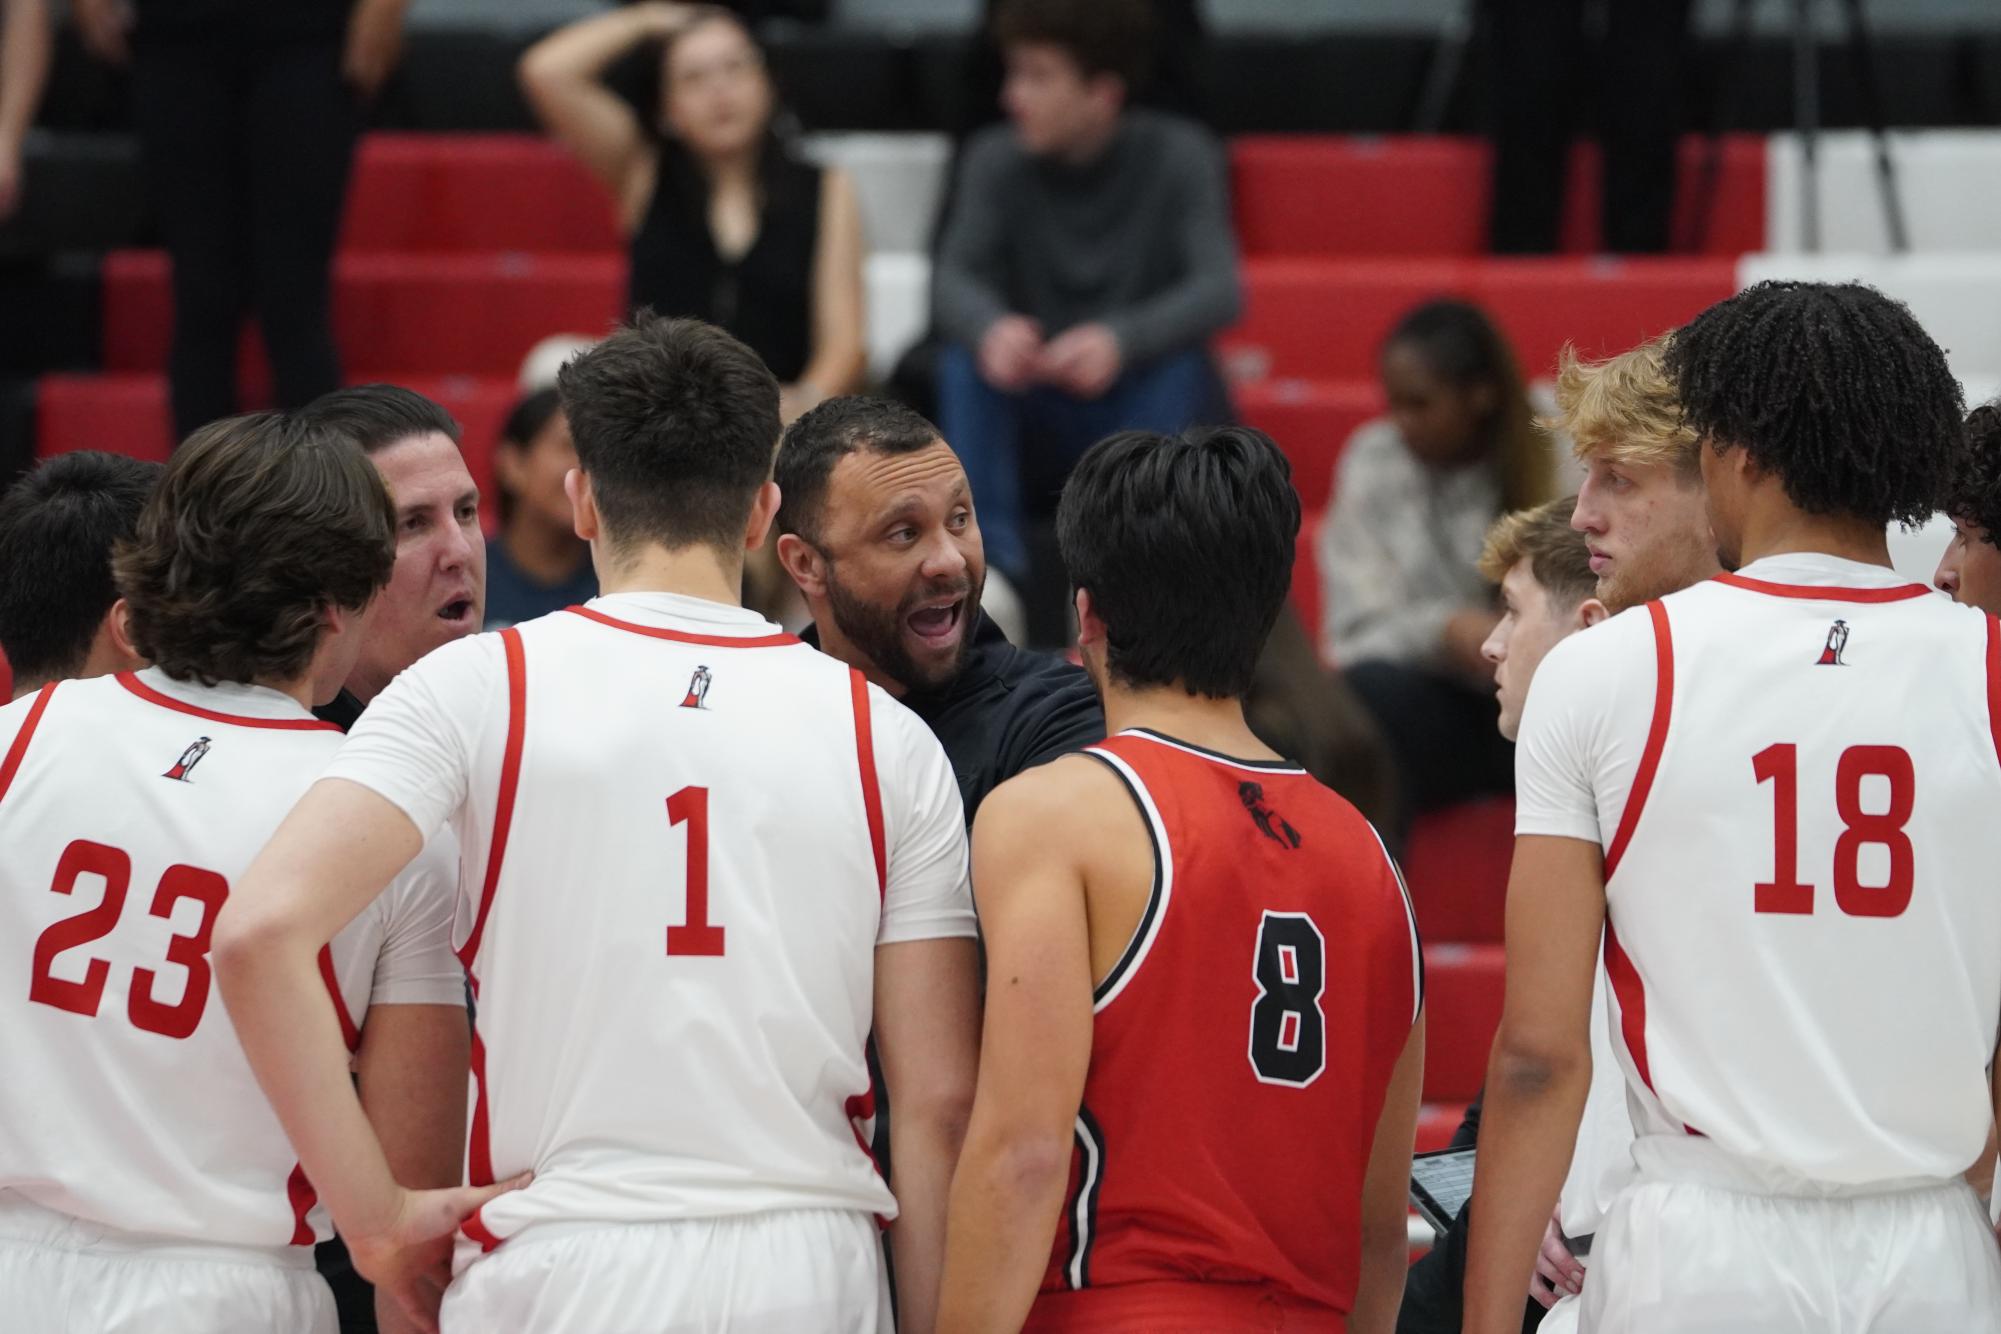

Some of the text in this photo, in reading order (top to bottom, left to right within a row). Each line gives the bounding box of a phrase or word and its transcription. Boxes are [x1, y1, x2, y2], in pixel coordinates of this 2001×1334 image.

[665, 785, 725, 957] 1
[1751, 743, 1915, 918] 18
[29, 839, 230, 1040] 23
[1248, 909, 1326, 1089] 8
